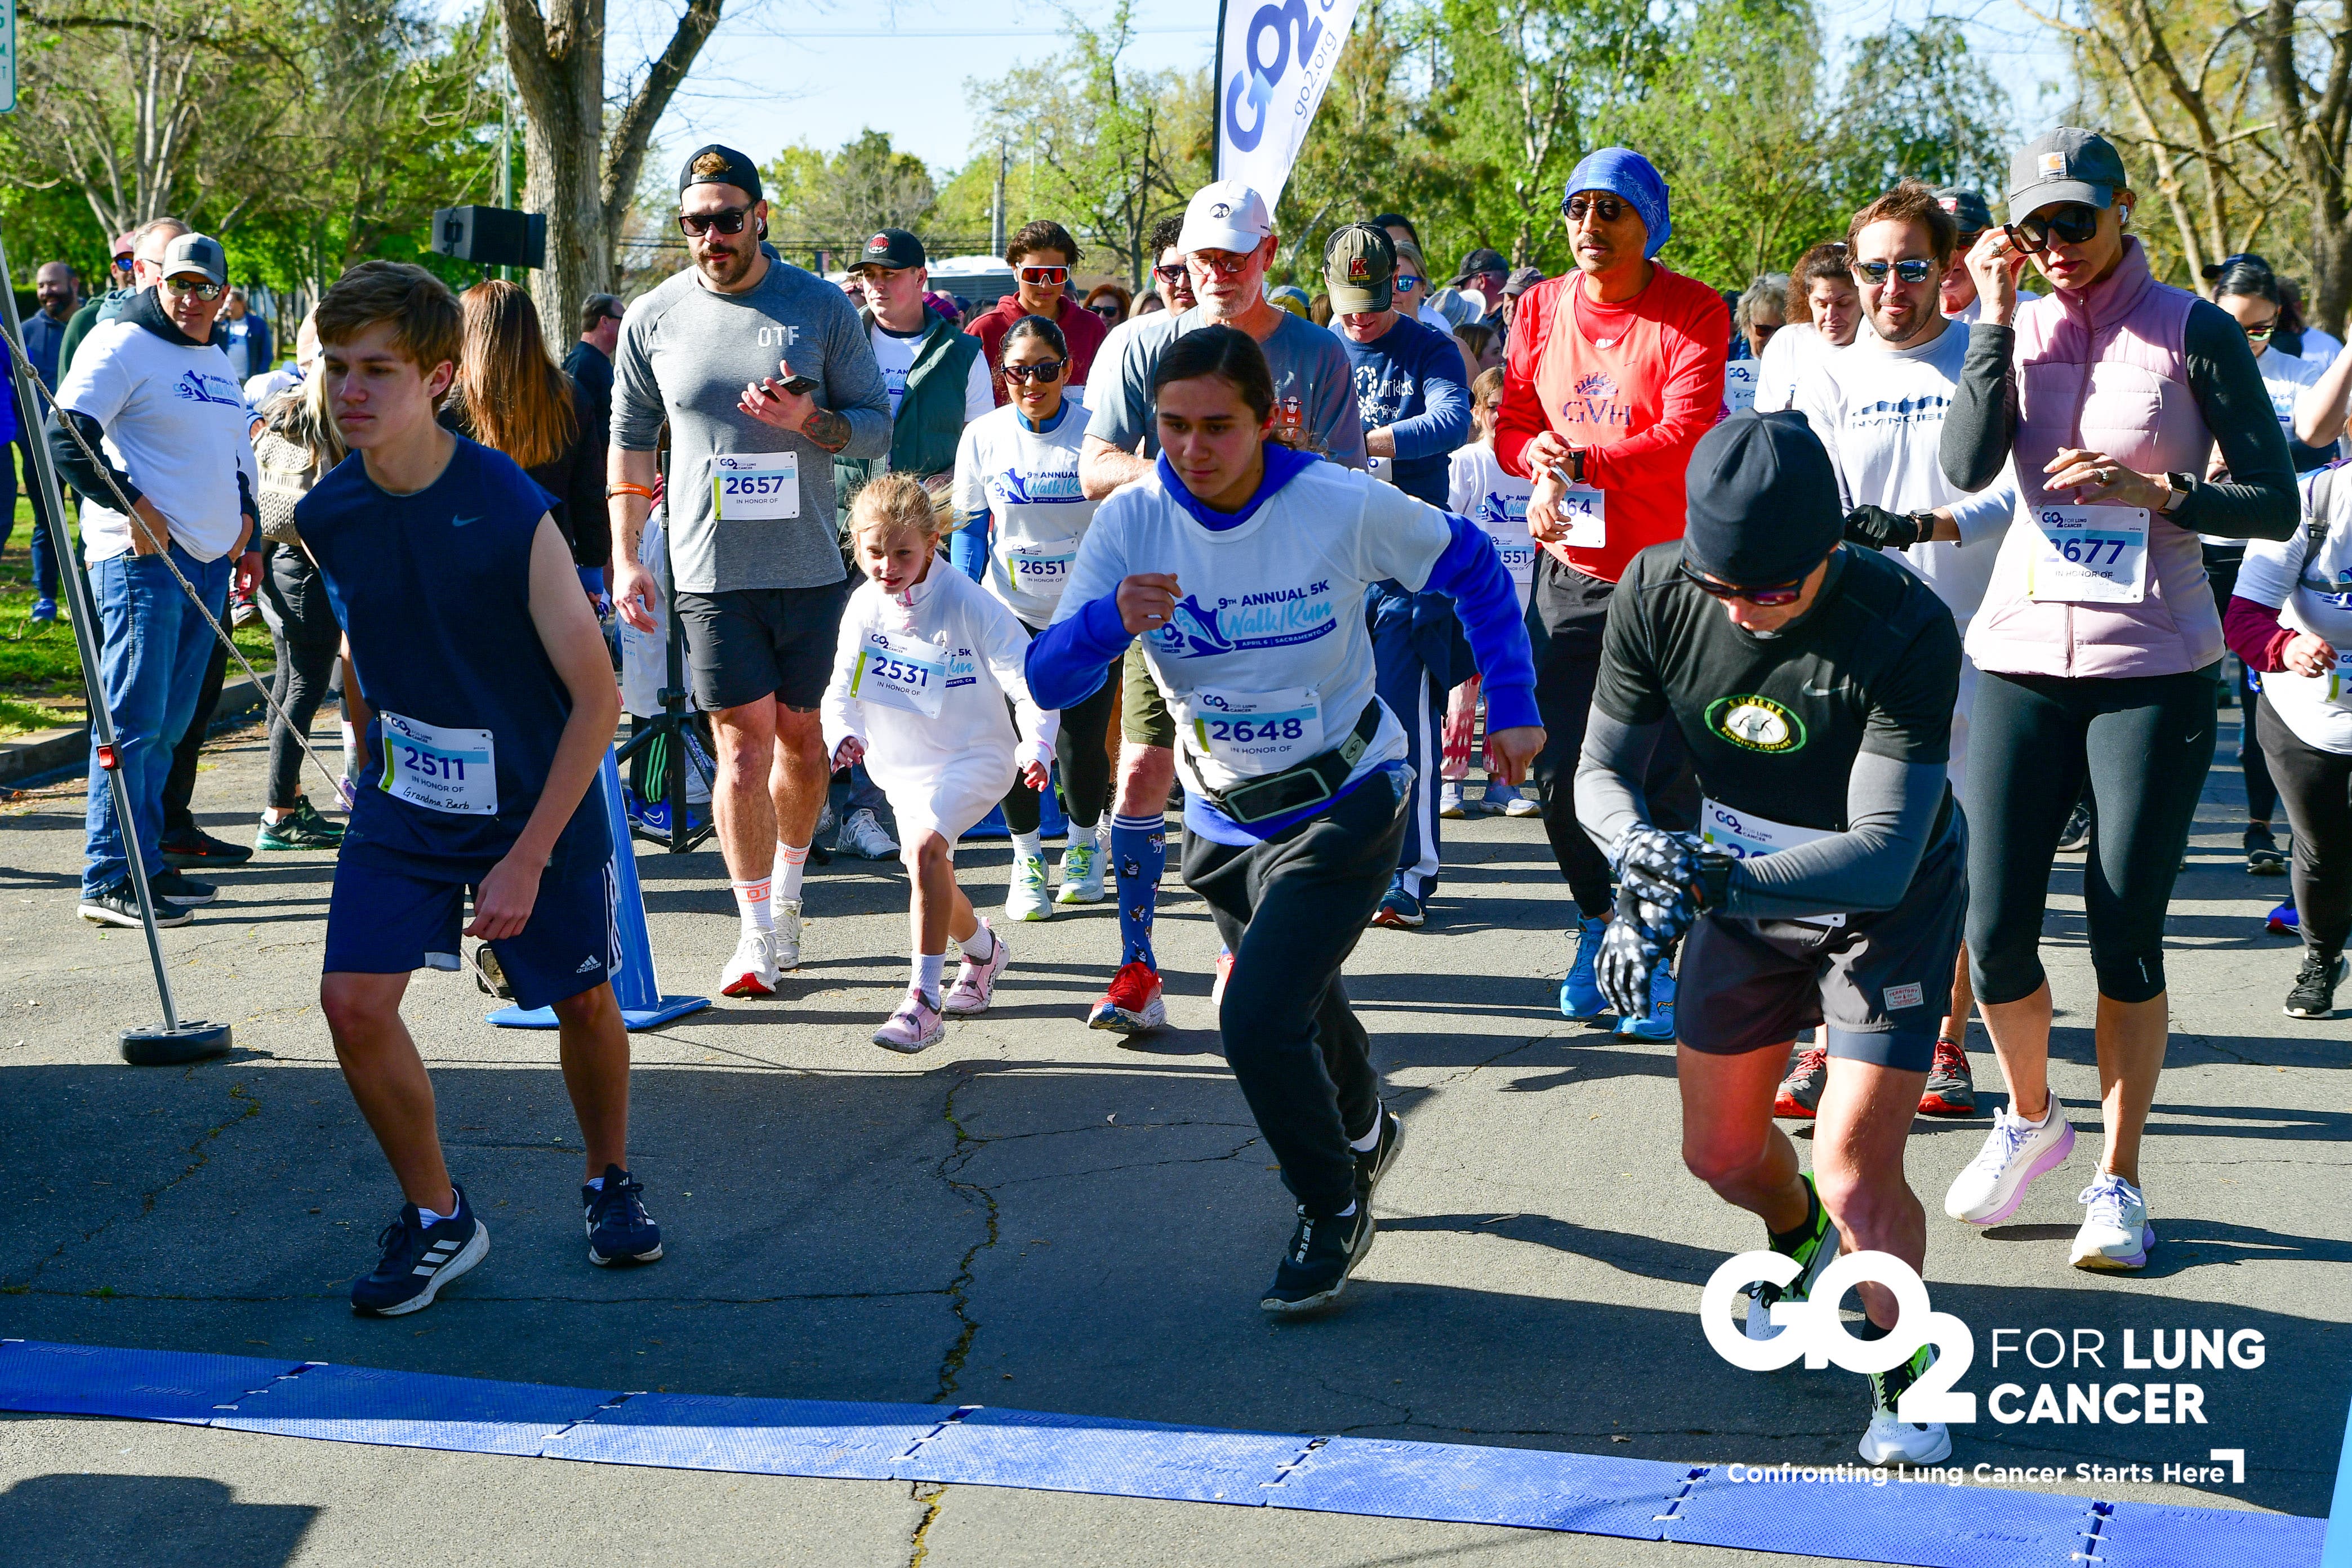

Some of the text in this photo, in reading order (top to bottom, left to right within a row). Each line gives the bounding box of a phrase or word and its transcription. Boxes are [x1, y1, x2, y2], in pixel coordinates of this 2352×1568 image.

[1295, 30, 1337, 119] go2.org
[1349, 258, 1367, 275] K
[758, 326, 799, 348] OTF
[1563, 398, 1631, 425] GVH
[720, 458, 738, 470] GO2
[726, 475, 784, 495] 2657
[2042, 511, 2064, 528] GO2
[2044, 538, 2126, 564] 2677
[1019, 559, 1066, 574] 2651
[1218, 580, 1330, 609] 9TH ANNUAL 5K
[871, 634, 889, 649] GO2
[1275, 630, 1324, 644] SACRAMENTO,
[1324, 623, 1333, 632] CA
[959, 648, 972, 657] 5K
[872, 656, 929, 687] 2531
[885, 683, 910, 694] HONOR
[1202, 694, 1230, 712] GO2
[1728, 697, 1784, 718] EUGENE
[391, 717, 412, 737] GO2
[1211, 718, 1303, 742] 2648
[1242, 745, 1277, 754] HONOR
[404, 746, 464, 781] 2511
[412, 775, 420, 784] IN
[421, 777, 449, 792] HONOR
[403, 787, 469, 810] Grandma Barb
[1715, 810, 1742, 835] GO2
[1743, 832, 1766, 841] CANCER
[576, 962, 602, 973] adidas
